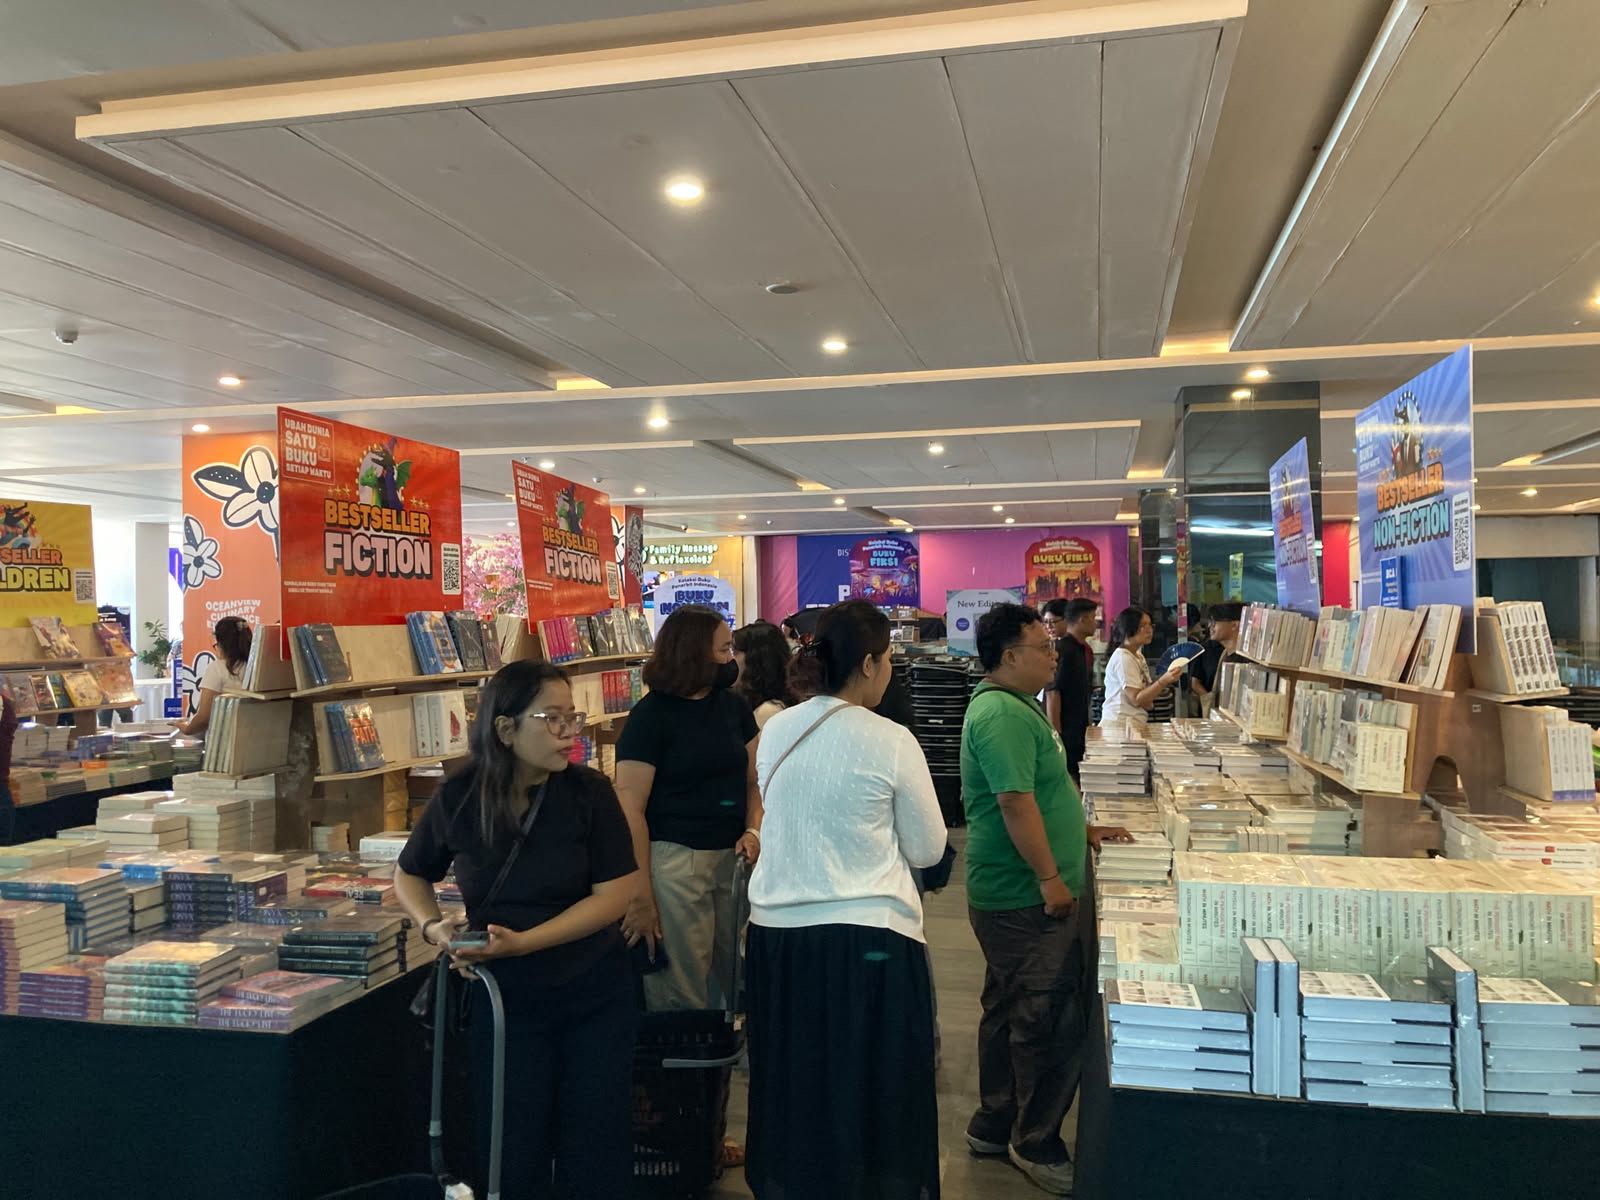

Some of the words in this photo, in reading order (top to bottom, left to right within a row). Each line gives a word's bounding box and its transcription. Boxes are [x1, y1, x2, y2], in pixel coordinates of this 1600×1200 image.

[285, 430, 316, 449] SATU
[285, 446, 317, 466] BUKU
[1377, 463, 1445, 511] BESTSELLER
[325, 499, 430, 535] BESTSELLER
[1374, 499, 1450, 547] NON-FICTION
[542, 525, 599, 554] BESTSELLER
[0, 548, 62, 565] SELLER
[325, 531, 431, 575] FICTION
[649, 544, 681, 554] Family
[837, 548, 850, 557] DIS
[544, 547, 602, 583] FICTION
[649, 556, 658, 565] &
[870, 557, 899, 567] FIKSI
[1033, 554, 1063, 564] BUKU
[675, 590, 714, 602] BUKU
[957, 600, 976, 608] New
[205, 599, 261, 612] OCEANVIEW
[210, 606, 256, 621] CULINARY
